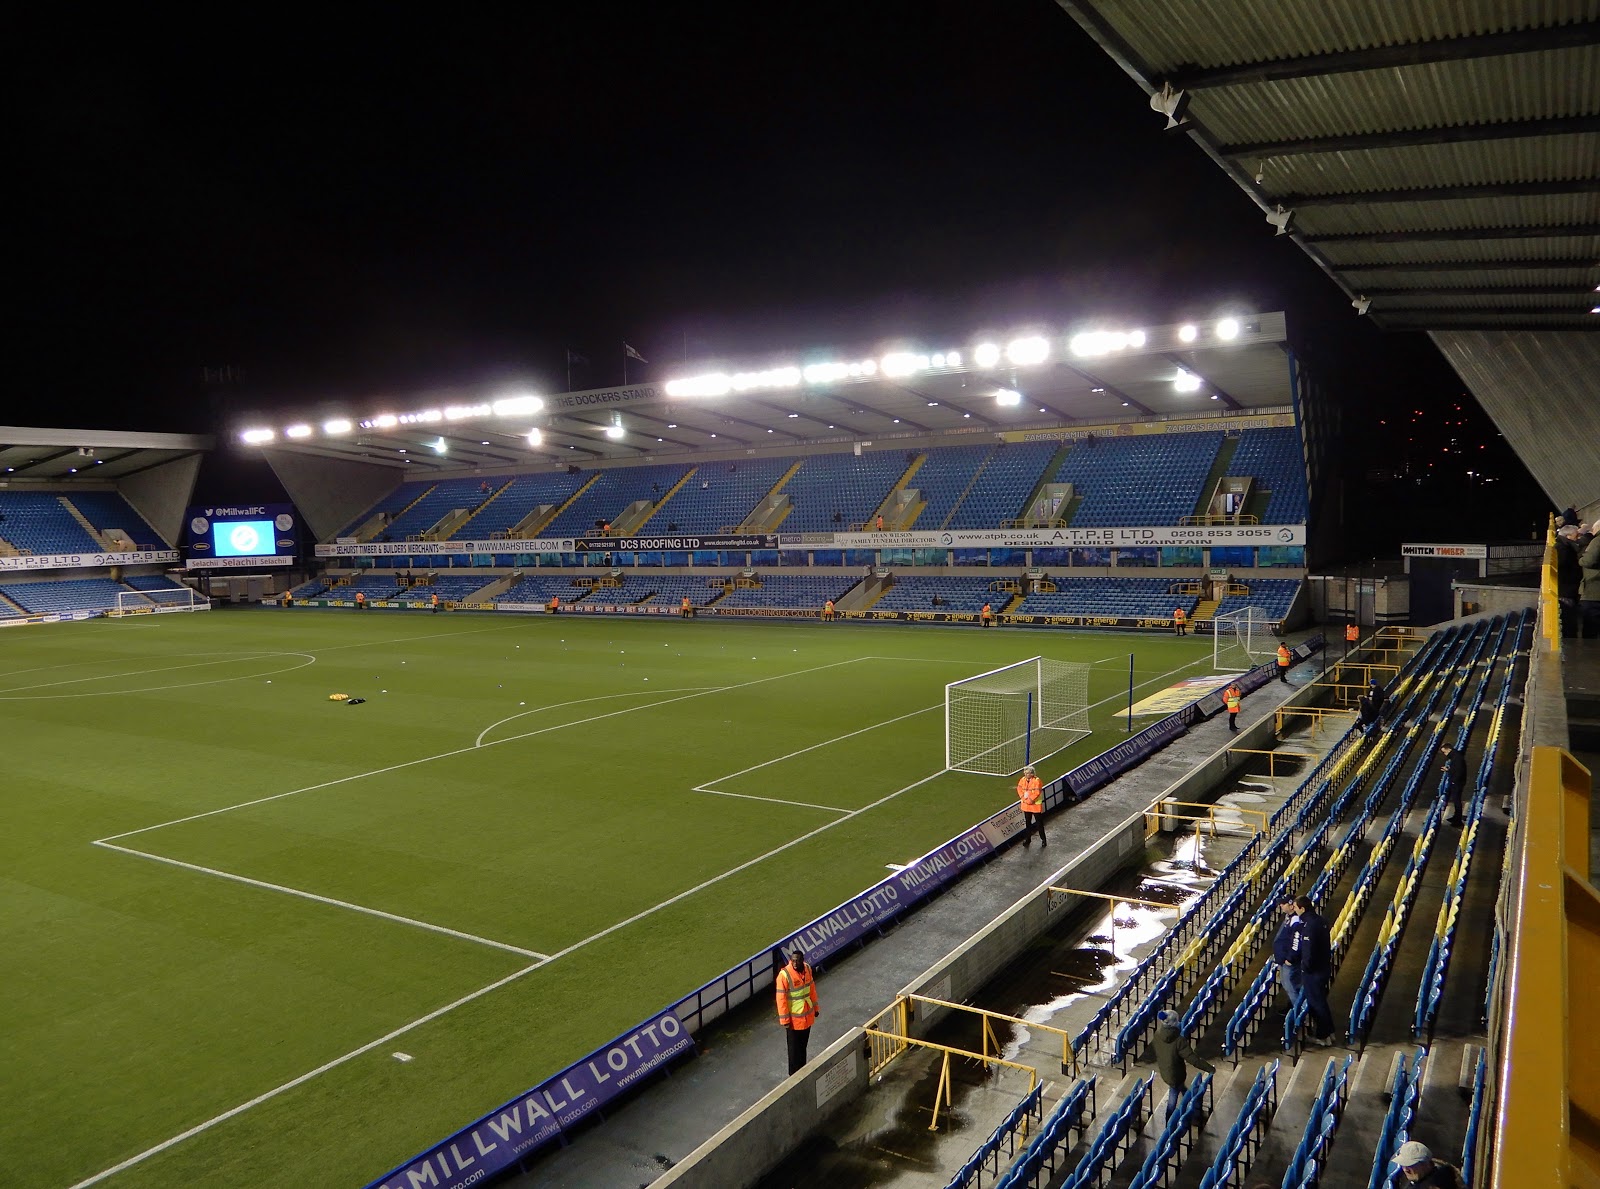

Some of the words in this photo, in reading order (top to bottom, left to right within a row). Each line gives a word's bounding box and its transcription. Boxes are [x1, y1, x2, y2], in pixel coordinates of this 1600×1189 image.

[557, 396, 574, 407] THE
[576, 391, 621, 406] DOCKERS
[623, 387, 655, 401] STAND
[1165, 423, 1205, 433] ZAMPA'S
[1207, 421, 1240, 430] FAMILY
[1242, 420, 1268, 429] CLUB
[1024, 432, 1059, 441] ZAMPA'S
[1060, 431, 1090, 440] FAMILY
[215, 506, 266, 517] @MillwallFC
[957, 532, 1039, 541] www.atpb.co.uk
[1052, 530, 1114, 540] A.T.P.B
[1120, 529, 1154, 540] LTD
[1170, 530, 1204, 538] 0208
[1237, 529, 1272, 537] 3055
[336, 545, 358, 555] SELHURST
[359, 545, 378, 554] TIMBER
[383, 544, 407, 554] BUILDERS
[407, 543, 439, 554] MERCHANTS
[477, 540, 559, 551] WWW.MAHSTEEL.COM
[620, 539, 639, 550] DCS
[640, 538, 681, 549] ROOFING
[683, 538, 700, 549] LTD
[704, 539, 760, 547] www.dcsroofingltd.co.uk
[106, 552, 153, 562] A.T.P.B
[157, 551, 180, 559] LTD
[1436, 547, 1465, 556] TIMBER
[54, 555, 81, 564] LTD
[222, 558, 257, 566] Selachii
[260, 557, 287, 565] Selachii
[407, 601, 436, 609] bet365.co
[720, 608, 816, 618] KENTFLOORINGUK.CO.UK
[1051, 616, 1075, 624] energy
[1093, 617, 1118, 625] energy
[1135, 724, 1164, 748] MILLWALL
[1161, 715, 1182, 731] LOTTO
[1073, 758, 1113, 784] MILLWALL
[1111, 744, 1134, 762] LOTTO
[990, 816, 1008, 830] Remain
[900, 850, 955, 891] MILLWALL
[950, 831, 987, 860] LOTTO
[780, 908, 858, 962] MILLWALL
[852, 884, 898, 919] LOTTO
[616, 1038, 689, 1088] www.millwalllotto.com
[406, 1078, 586, 1189] MILLWALL
[588, 1015, 680, 1084] LOTTO
